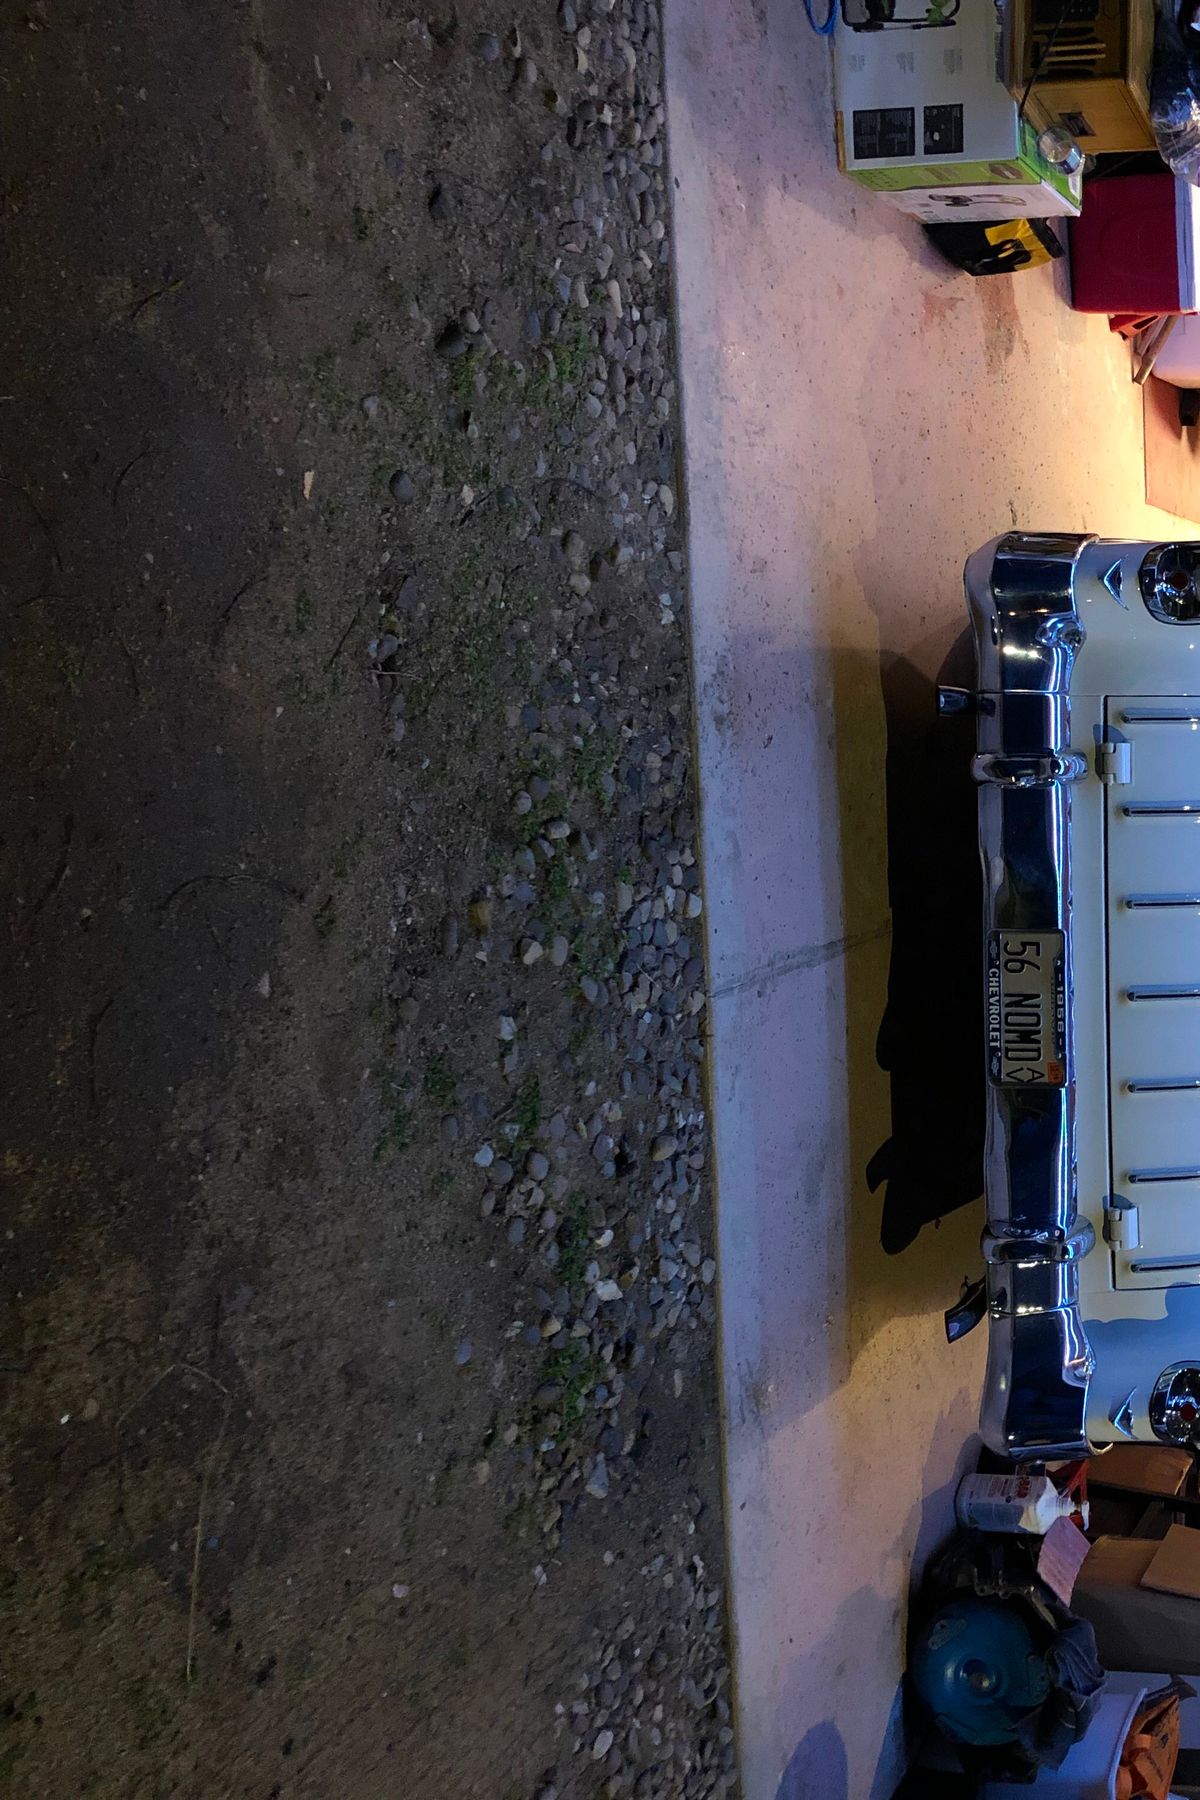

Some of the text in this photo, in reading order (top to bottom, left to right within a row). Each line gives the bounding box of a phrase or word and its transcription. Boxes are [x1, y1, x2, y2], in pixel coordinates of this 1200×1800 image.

[1004, 940, 1042, 974] 56
[988, 968, 1000, 1048] CHEVROLET
[1004, 993, 1042, 1062] NOMD
[1056, 986, 1064, 1032] 1956
